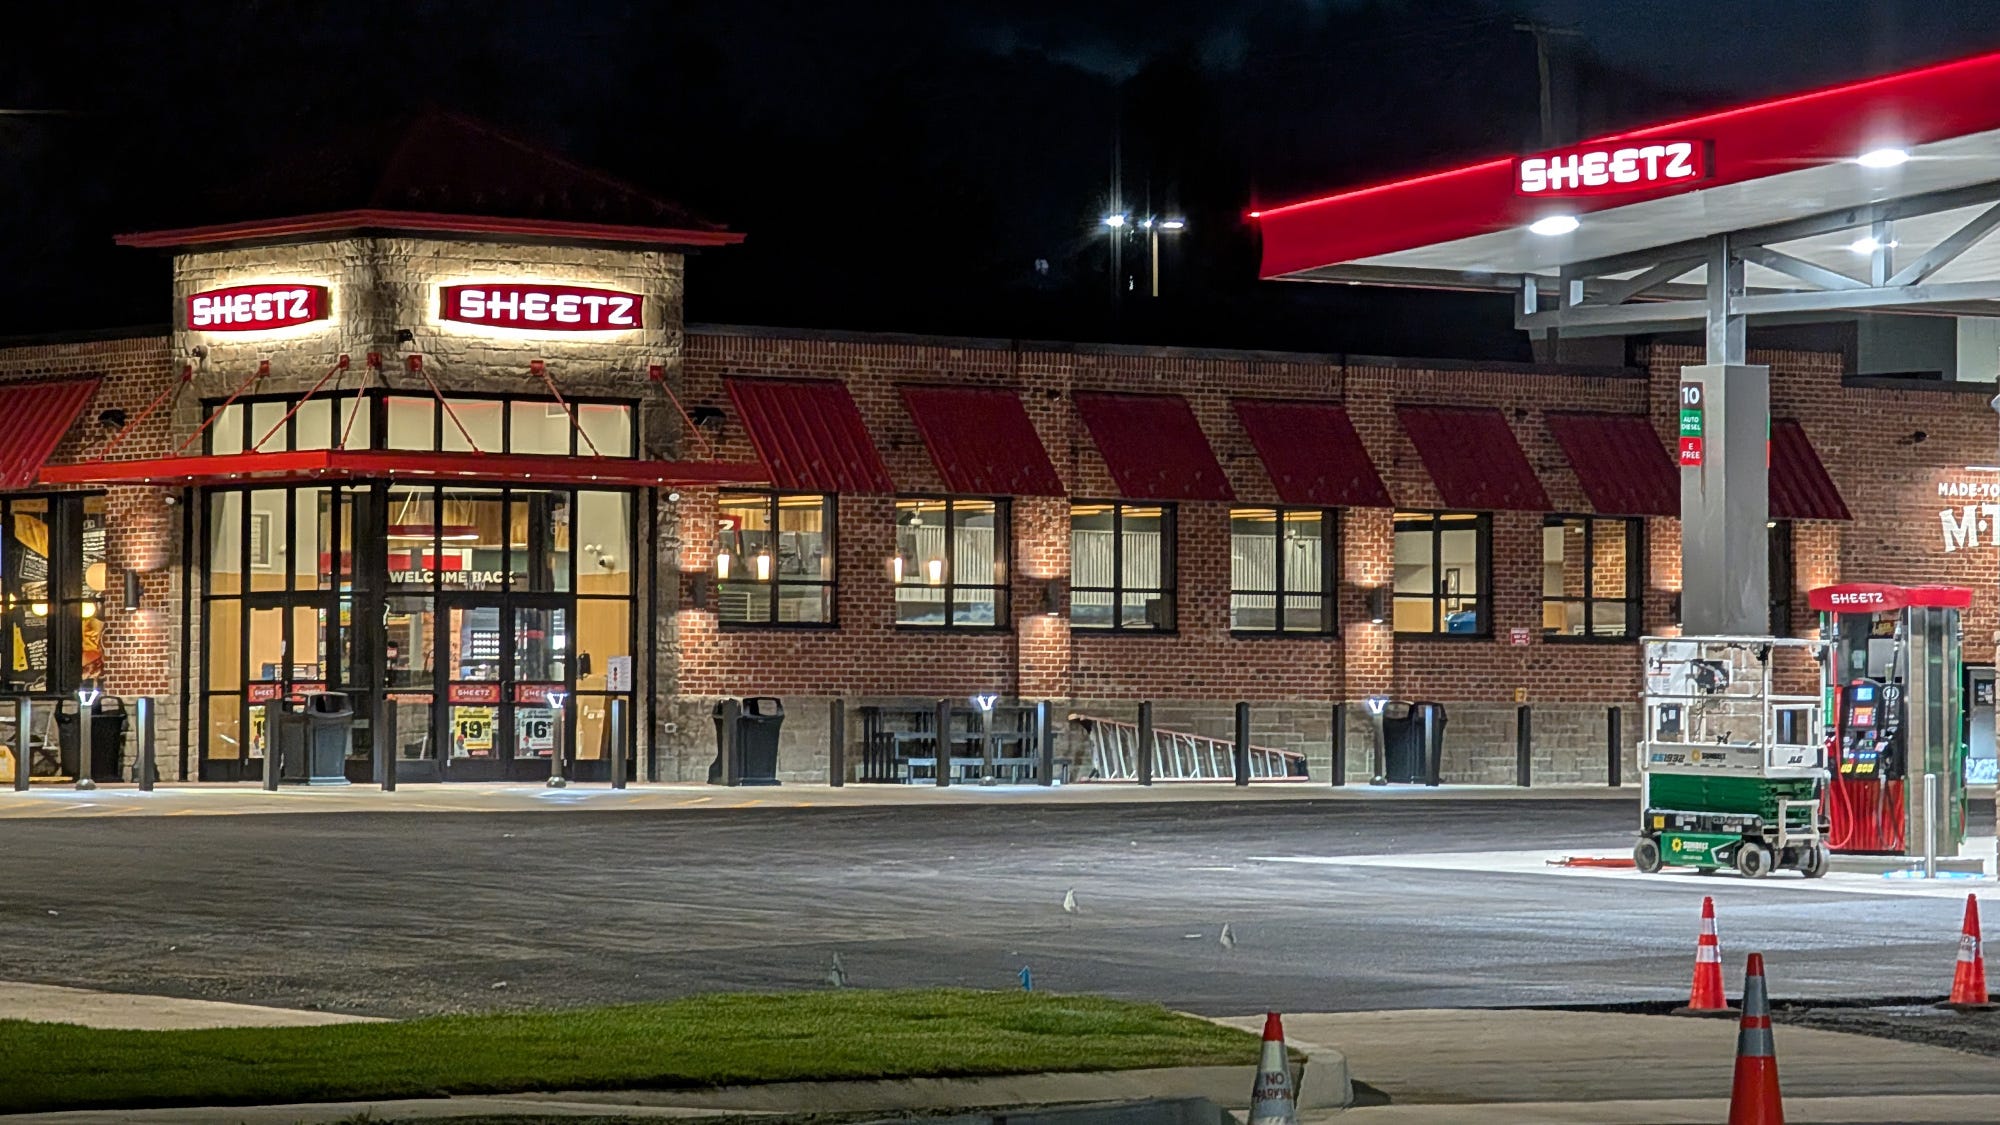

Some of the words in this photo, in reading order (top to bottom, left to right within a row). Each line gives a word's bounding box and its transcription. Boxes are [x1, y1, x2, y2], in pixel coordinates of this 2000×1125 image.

[1521, 143, 1692, 192] SHEETZ
[193, 289, 308, 326] SHEETZ
[460, 290, 633, 325] SHEETZ
[1681, 387, 1700, 404] 10
[1682, 451, 1700, 459] FREE
[389, 571, 467, 583] WELCME
[1831, 592, 1884, 604] SHEETZ
[1788, 755, 1804, 764] JLG
[1265, 1072, 1285, 1085] NO
[1253, 1087, 1293, 1103] PARKIN
